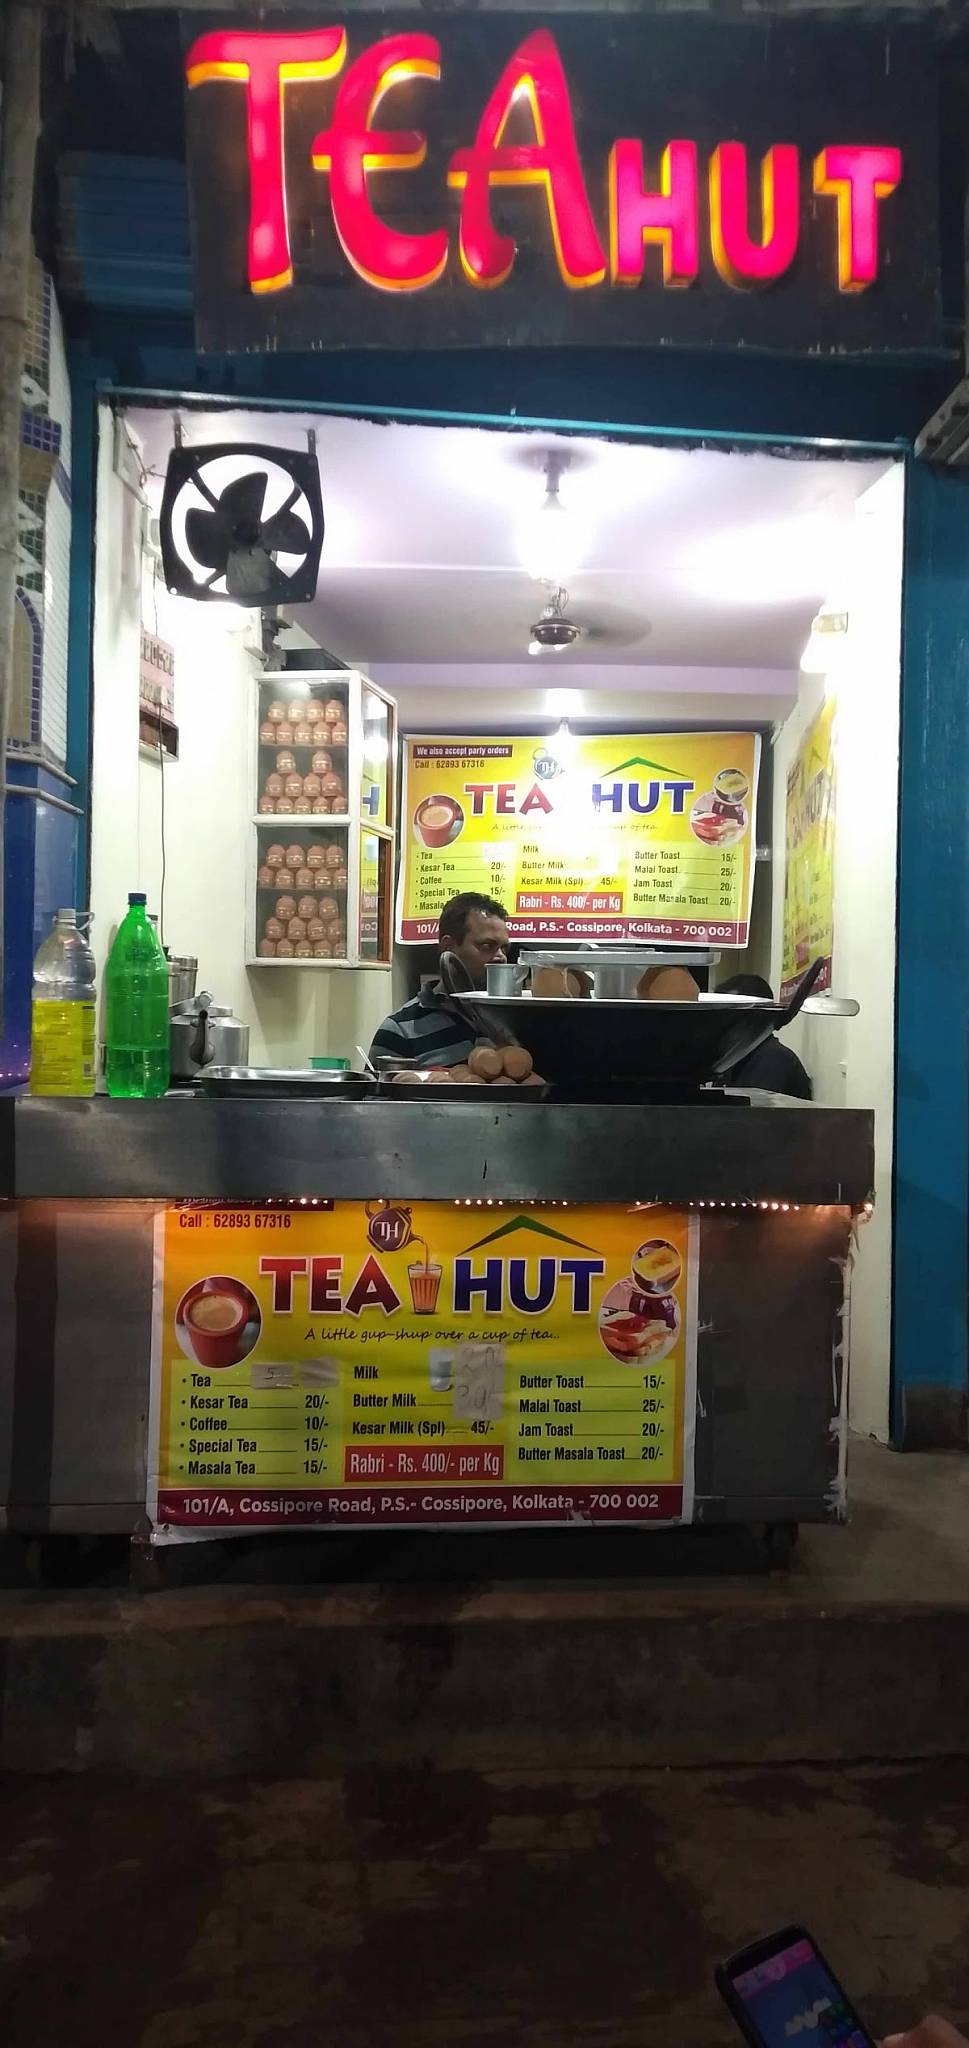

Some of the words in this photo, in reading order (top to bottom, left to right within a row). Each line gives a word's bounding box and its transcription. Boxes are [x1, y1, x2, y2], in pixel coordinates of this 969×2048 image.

[187, 26, 608, 292] TEA
[609, 138, 904, 292] HUT
[429, 747, 444, 755] also
[445, 747, 467, 756] accept
[468, 747, 486, 756] party
[487, 746, 509, 755] orders
[415, 760, 429, 768] Call
[436, 760, 459, 769] 62893
[461, 760, 485, 768] 67316
[465, 783, 554, 816] TEA
[592, 781, 695, 813] HUT
[421, 852, 433, 860] Tea
[523, 845, 539, 853] Milk
[634, 851, 658, 859] Butter
[660, 851, 680, 859] Toast
[722, 853, 737, 862] 15/-
[421, 864, 441, 872] Kesar
[443, 863, 455, 871] Tea
[491, 862, 506, 870] 20/-
[522, 861, 545, 869] Butter
[548, 861, 564, 869] Milk
[658, 865, 678, 873] Toast
[720, 868, 736, 877] 25/-
[420, 876, 442, 884] Coffee
[490, 874, 506, 883] 10/-
[521, 877, 543, 885] Kesar
[545, 877, 562, 885] Milk
[564, 877, 584, 887] (Spl)
[600, 877, 617, 885] 45/-
[633, 879, 650, 887] Jam
[652, 879, 672, 887] Toast
[720, 882, 736, 891] 20/-
[420, 888, 445, 898] Special
[447, 887, 460, 896] Tea
[490, 887, 506, 895] 15/-
[633, 893, 656, 902] Butter
[688, 895, 708, 905] Toast
[719, 897, 736, 906] 20/-
[519, 896, 542, 908] Rabri
[551, 896, 565, 908] Rs.
[566, 896, 591, 909] 400/-
[592, 898, 607, 911] per
[609, 896, 620, 910] Kg
[505, 921, 536, 933] Road,
[567, 922, 626, 934] Cossipore,
[629, 922, 672, 934] Kolkata
[683, 925, 706, 935] 700
[708, 926, 733, 936] 002
[179, 1213, 202, 1228] Call
[213, 1213, 251, 1228] 62893
[254, 1213, 291, 1228] 67316
[373, 1221, 400, 1242] TH
[259, 1254, 401, 1318] TEA
[453, 1256, 606, 1316] HUT
[305, 1330, 316, 1340] A
[321, 1327, 357, 1340] little
[360, 1328, 432, 1343] gup-shup
[434, 1331, 464, 1340] over
[468, 1331, 480, 1340] a
[482, 1331, 510, 1343] cup
[512, 1327, 529, 1343] of
[354, 1366, 379, 1380] Milk
[190, 1374, 211, 1388] Tea
[519, 1375, 553, 1389] Butter
[556, 1375, 584, 1389] Toast
[643, 1375, 666, 1389] 15/-
[190, 1396, 224, 1410] Kesar
[226, 1395, 248, 1409] Tea
[305, 1395, 329, 1409] 20/-
[353, 1394, 390, 1408] Butter
[392, 1393, 417, 1407] Milk
[519, 1399, 550, 1413] Malai
[553, 1399, 581, 1413] Toast
[642, 1399, 665, 1413] 25/-
[189, 1417, 228, 1431] Coffee
[305, 1416, 328, 1431] 10/-
[352, 1421, 386, 1436] Kesar
[389, 1420, 415, 1436] Milk
[418, 1421, 446, 1437] (Spl)
[470, 1420, 495, 1435] 45/-
[518, 1423, 542, 1437] Jam
[545, 1423, 573, 1437] Toast
[642, 1423, 665, 1437] 20/-
[189, 1438, 233, 1456] Special
[236, 1438, 257, 1453] Tea
[304, 1437, 328, 1452] 15/-
[518, 1447, 551, 1461] Butter
[554, 1447, 594, 1461] Masala
[597, 1447, 626, 1461] Toast
[641, 1446, 664, 1461] 20/-
[188, 1461, 233, 1475] Masala
[236, 1461, 256, 1475] Tea
[303, 1460, 328, 1475] 15/-
[350, 1453, 385, 1474] Rabri
[397, 1454, 417, 1473] Rs.
[421, 1453, 455, 1473] 400/-
[459, 1456, 480, 1476] per
[483, 1453, 500, 1475] Kg
[183, 1497, 235, 1516] 101/A,
[239, 1497, 324, 1517] Cossipore
[328, 1496, 376, 1515] Road,
[381, 1496, 417, 1512] P.S.-
[421, 1495, 508, 1515] Cossipore,
[512, 1494, 574, 1510] Kolkata
[589, 1494, 622, 1509] 700
[626, 1494, 659, 1509] 002
